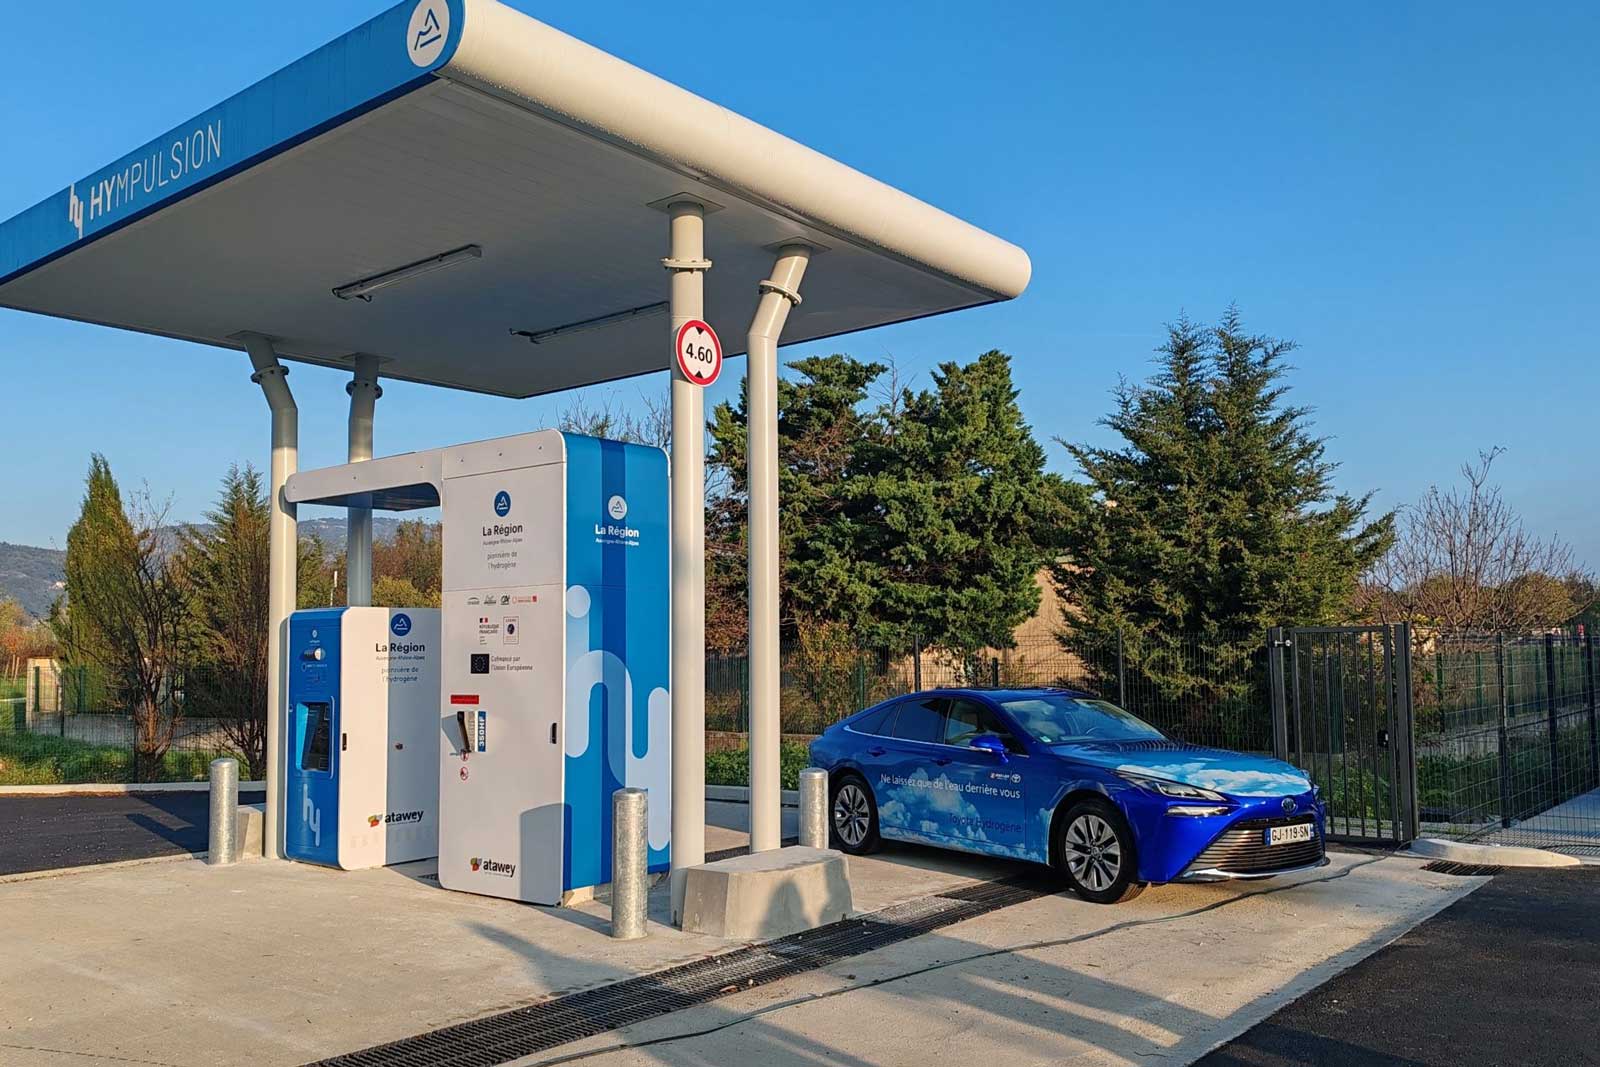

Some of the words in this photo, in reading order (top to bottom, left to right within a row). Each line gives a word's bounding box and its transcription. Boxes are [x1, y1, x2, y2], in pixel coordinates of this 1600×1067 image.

[90, 119, 222, 221] HYMPULSION
[686, 343, 713, 364] 4.60
[482, 526, 492, 537] La
[493, 523, 523, 537] Région
[595, 524, 606, 535] La
[607, 525, 640, 539] Région
[375, 642, 388, 653] La
[390, 641, 425, 654] Région
[880, 773, 891, 784] Ne
[917, 779, 932, 790] que
[933, 778, 944, 790] de
[965, 781, 998, 796] derrière
[999, 788, 1021, 799] vous
[384, 810, 424, 823] atawey
[1271, 825, 1309, 842] GJ-119-SN
[483, 859, 516, 878] atawey
